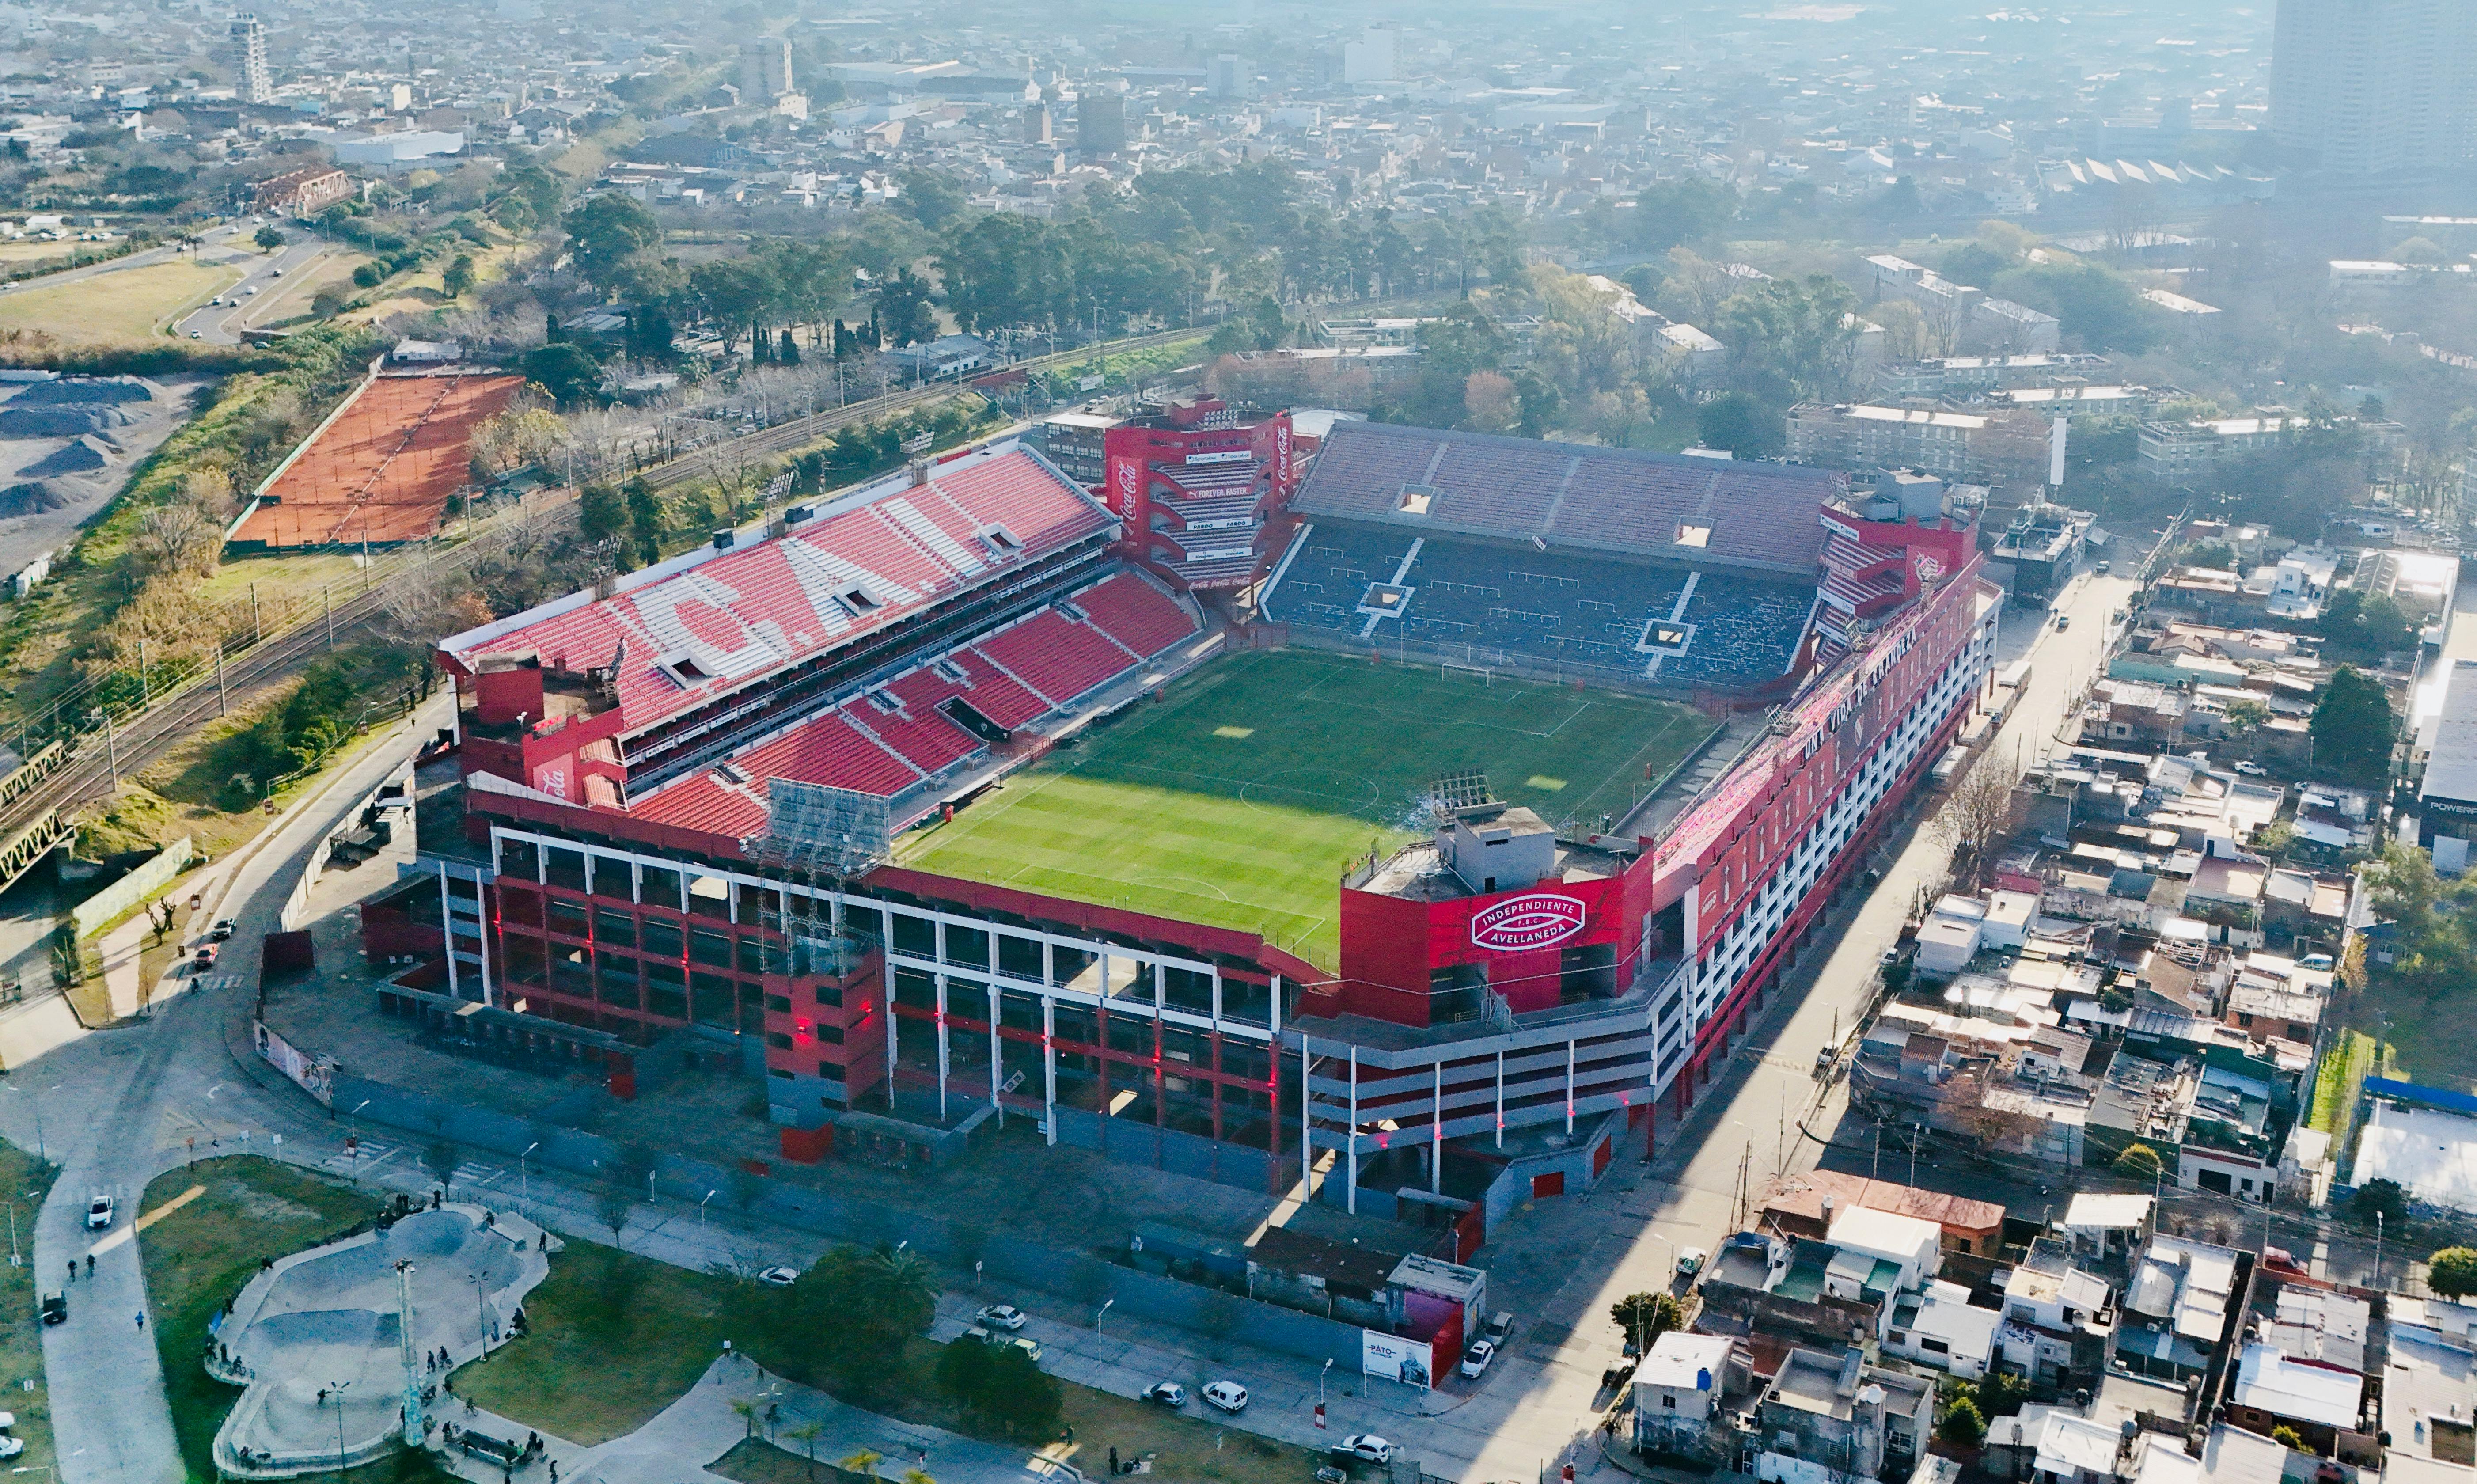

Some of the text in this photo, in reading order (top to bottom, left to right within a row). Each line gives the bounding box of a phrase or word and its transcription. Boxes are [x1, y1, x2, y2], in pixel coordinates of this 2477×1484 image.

[1119, 459, 1137, 521] Coca-Cola
[1831, 697, 1852, 731] VIDA
[1857, 679, 1867, 706] DE
[1482, 901, 1574, 926] INDEPENDIENTE
[1491, 924, 1566, 944] AVELLANEDA
